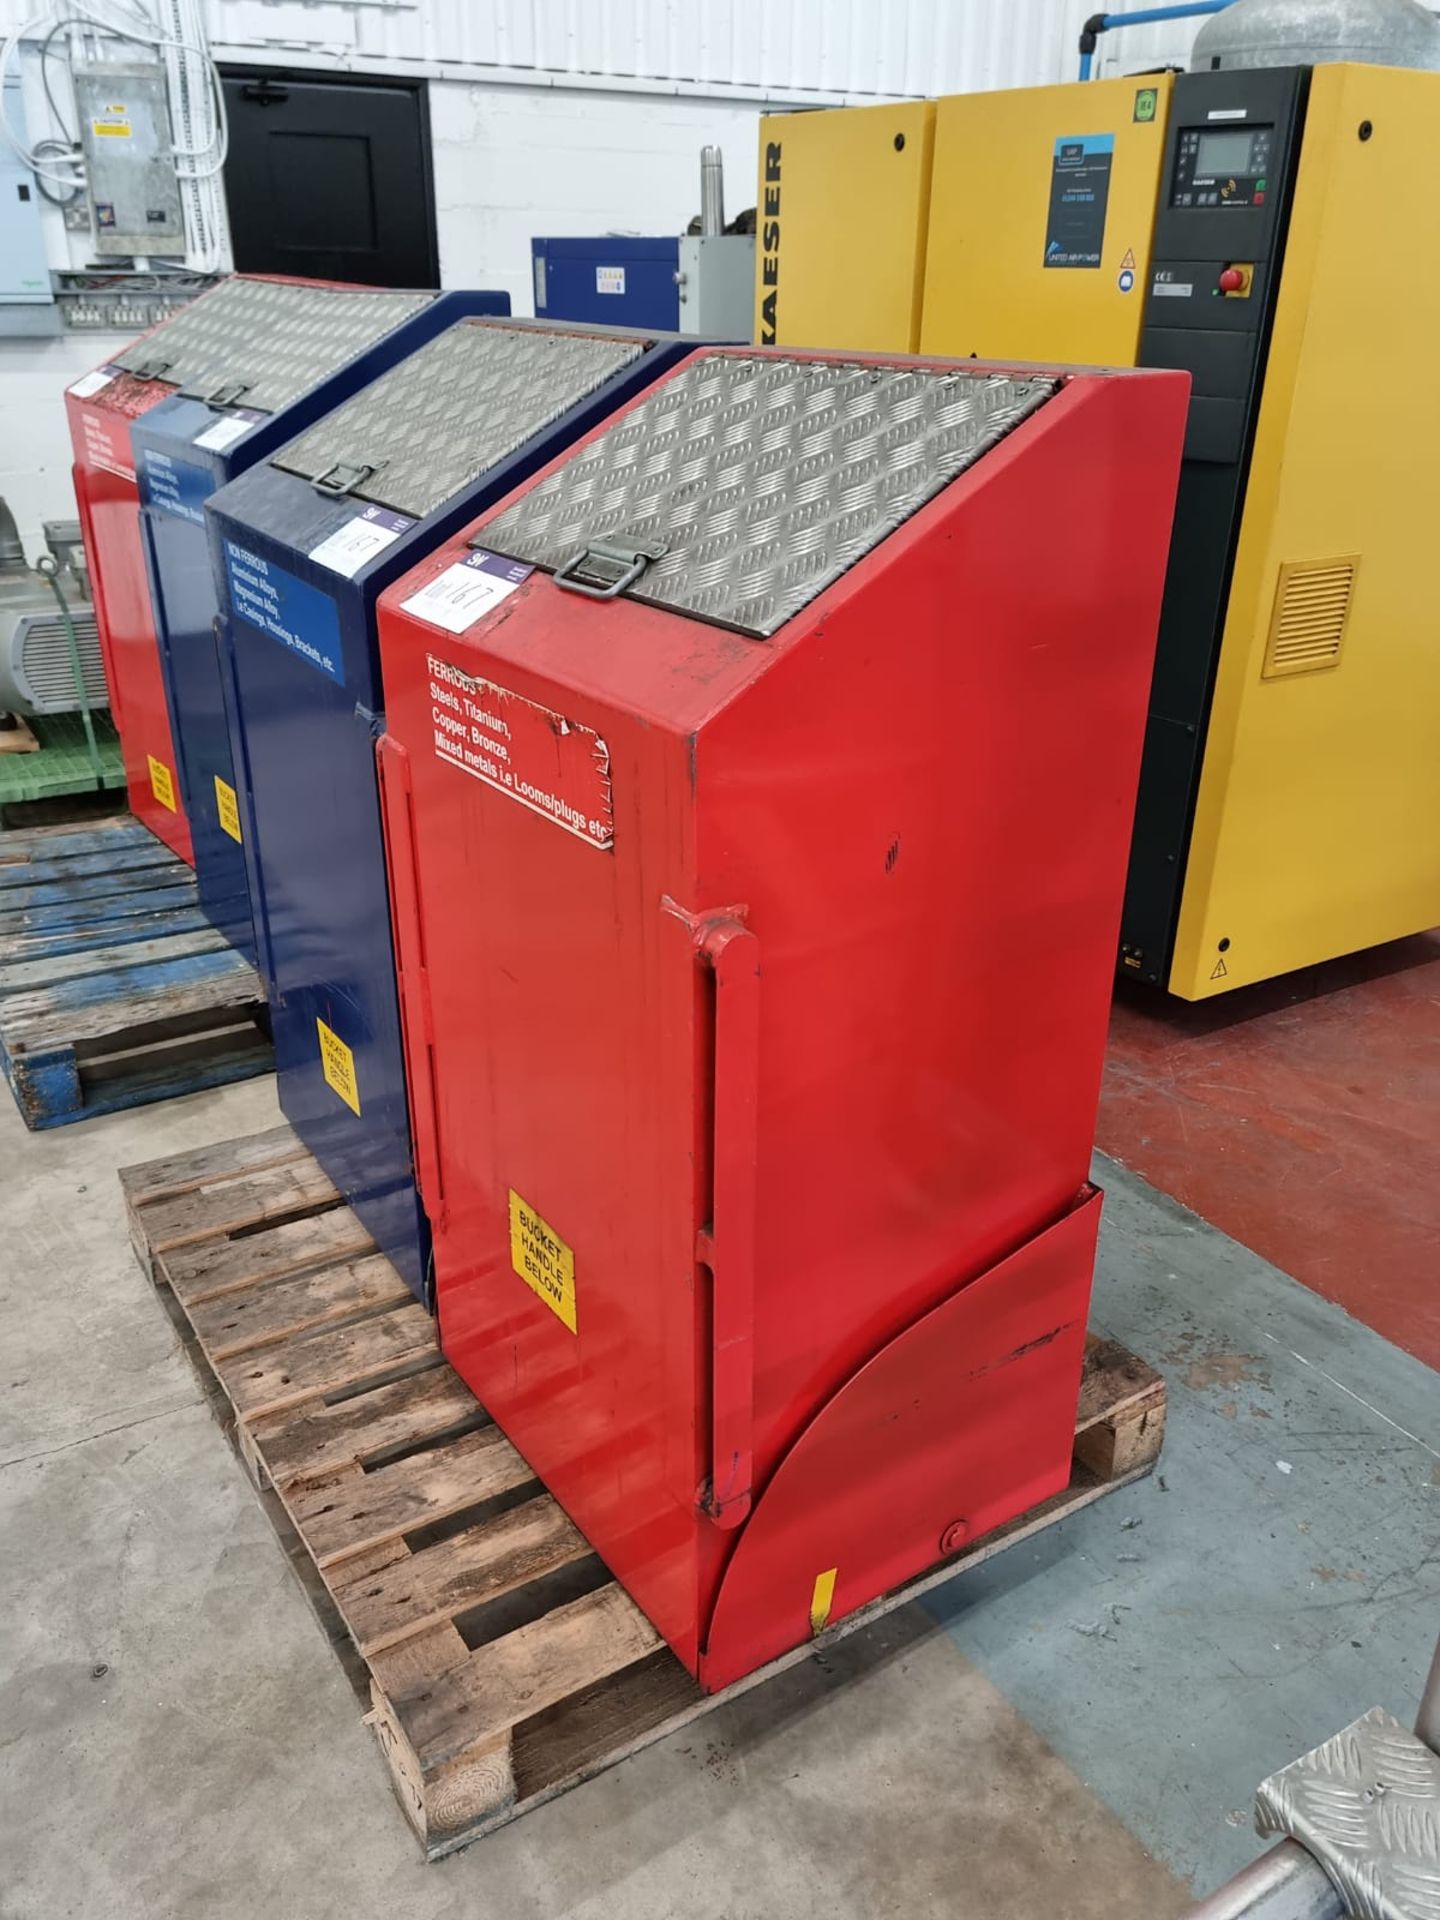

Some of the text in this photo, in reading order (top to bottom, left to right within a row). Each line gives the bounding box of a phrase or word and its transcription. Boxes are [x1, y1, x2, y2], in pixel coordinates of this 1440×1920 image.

[240, 548, 269, 576] FERROUS
[446, 581, 494, 610] 167
[427, 656, 477, 697] FERROUS
[430, 682, 512, 741] Steels, Titanium,
[432, 706, 512, 766] Copper, Bronze,
[434, 730, 463, 758] Mixed
[464, 751, 498, 779] metals
[514, 776, 587, 830] Looms/plugs
[519, 1210, 562, 1262] BUCKET
[521, 1232, 564, 1287] HANDLE
[525, 1255, 563, 1303] BELOW
